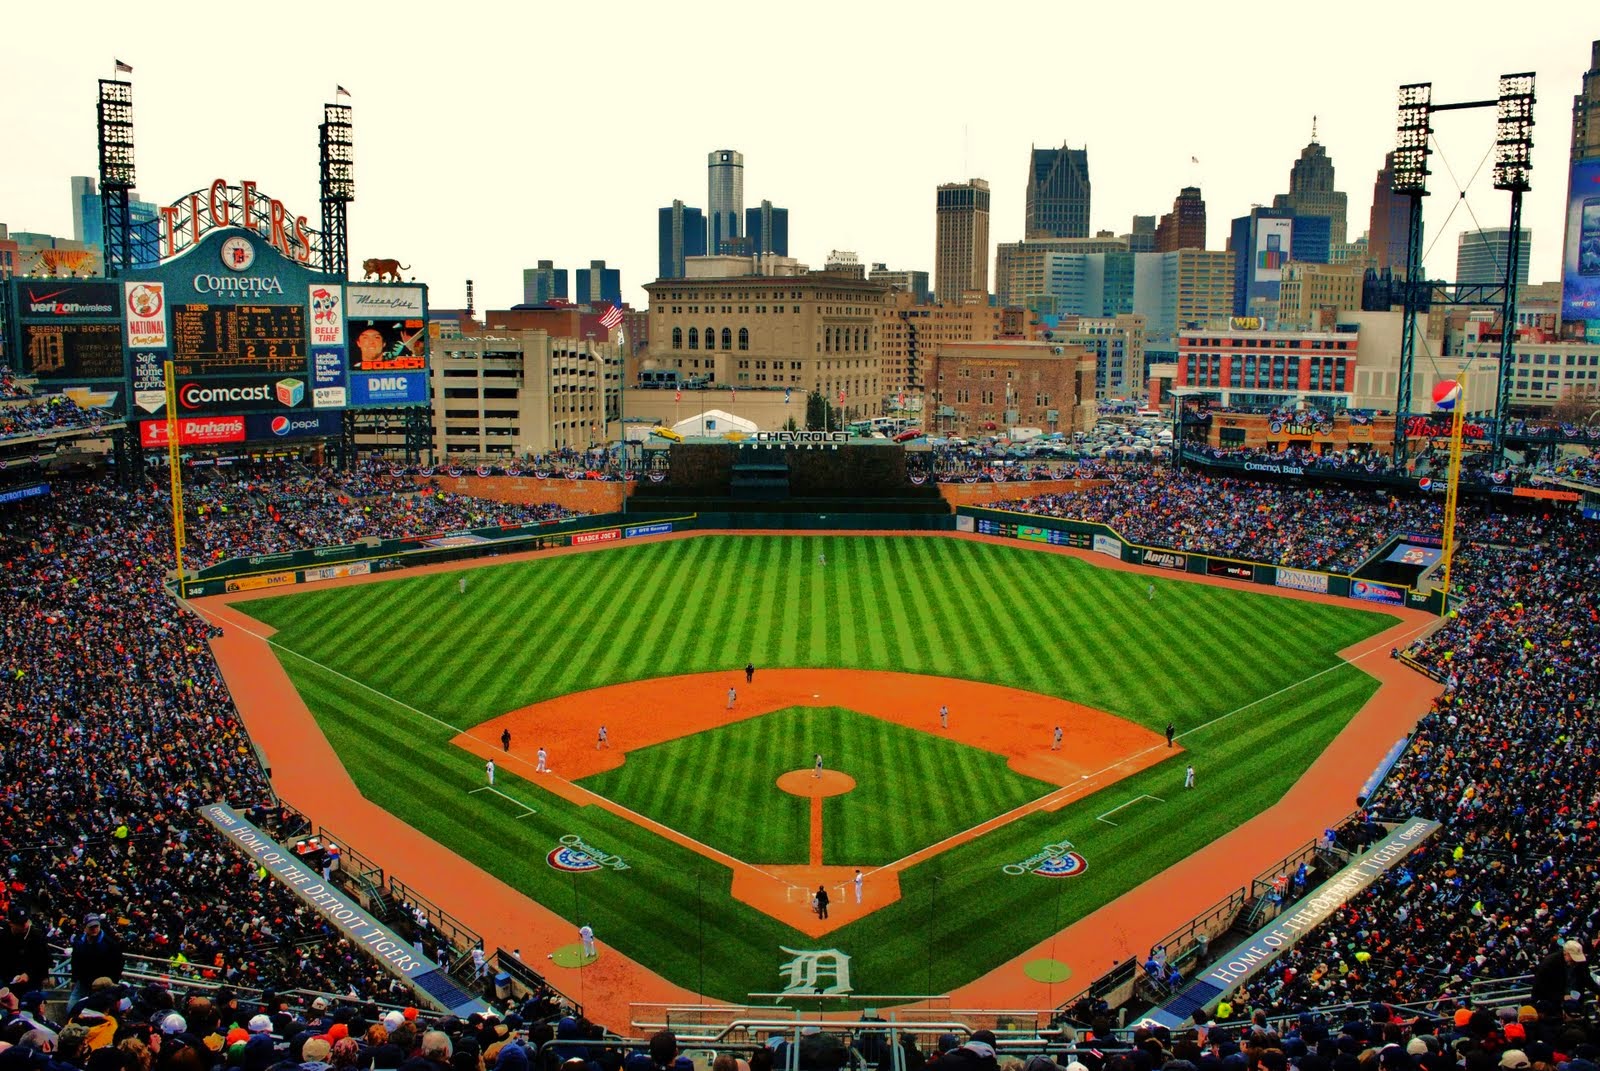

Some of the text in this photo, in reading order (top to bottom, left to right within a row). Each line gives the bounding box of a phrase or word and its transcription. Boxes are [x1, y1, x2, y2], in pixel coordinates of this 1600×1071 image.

[159, 178, 310, 262] TIGERS
[218, 290, 261, 298] PARK
[130, 320, 165, 335] NATIONAL
[1234, 316, 1259, 329] WJR
[318, 334, 337, 342] TIRE
[247, 345, 256, 357] 2
[269, 345, 277, 357] 2
[291, 345, 298, 357] 1
[136, 353, 156, 363] Safe
[136, 366, 163, 377] home
[134, 380, 166, 390] experts
[368, 377, 408, 391] DMC
[187, 384, 270, 403] comcast
[186, 420, 243, 434] Dunham's
[291, 418, 319, 430] pepsi
[757, 430, 854, 443] CHEVROLET
[1283, 466, 1304, 475] Bank
[23, 486, 42, 497] TIGERS
[577, 531, 617, 543] TRADER JOE'S
[1228, 566, 1251, 576] verizon
[1279, 569, 1327, 585] DYNAMIC
[267, 576, 288, 584] DMC
[1371, 587, 1402, 599] TOTAL
[230, 826, 421, 971] HOME OF THE DETROIT TIGERS
[1211, 946, 1269, 983] HOME
[1263, 929, 1289, 946] OF
[1282, 908, 1318, 930] THE
[1360, 840, 1407, 877] TIGERS
